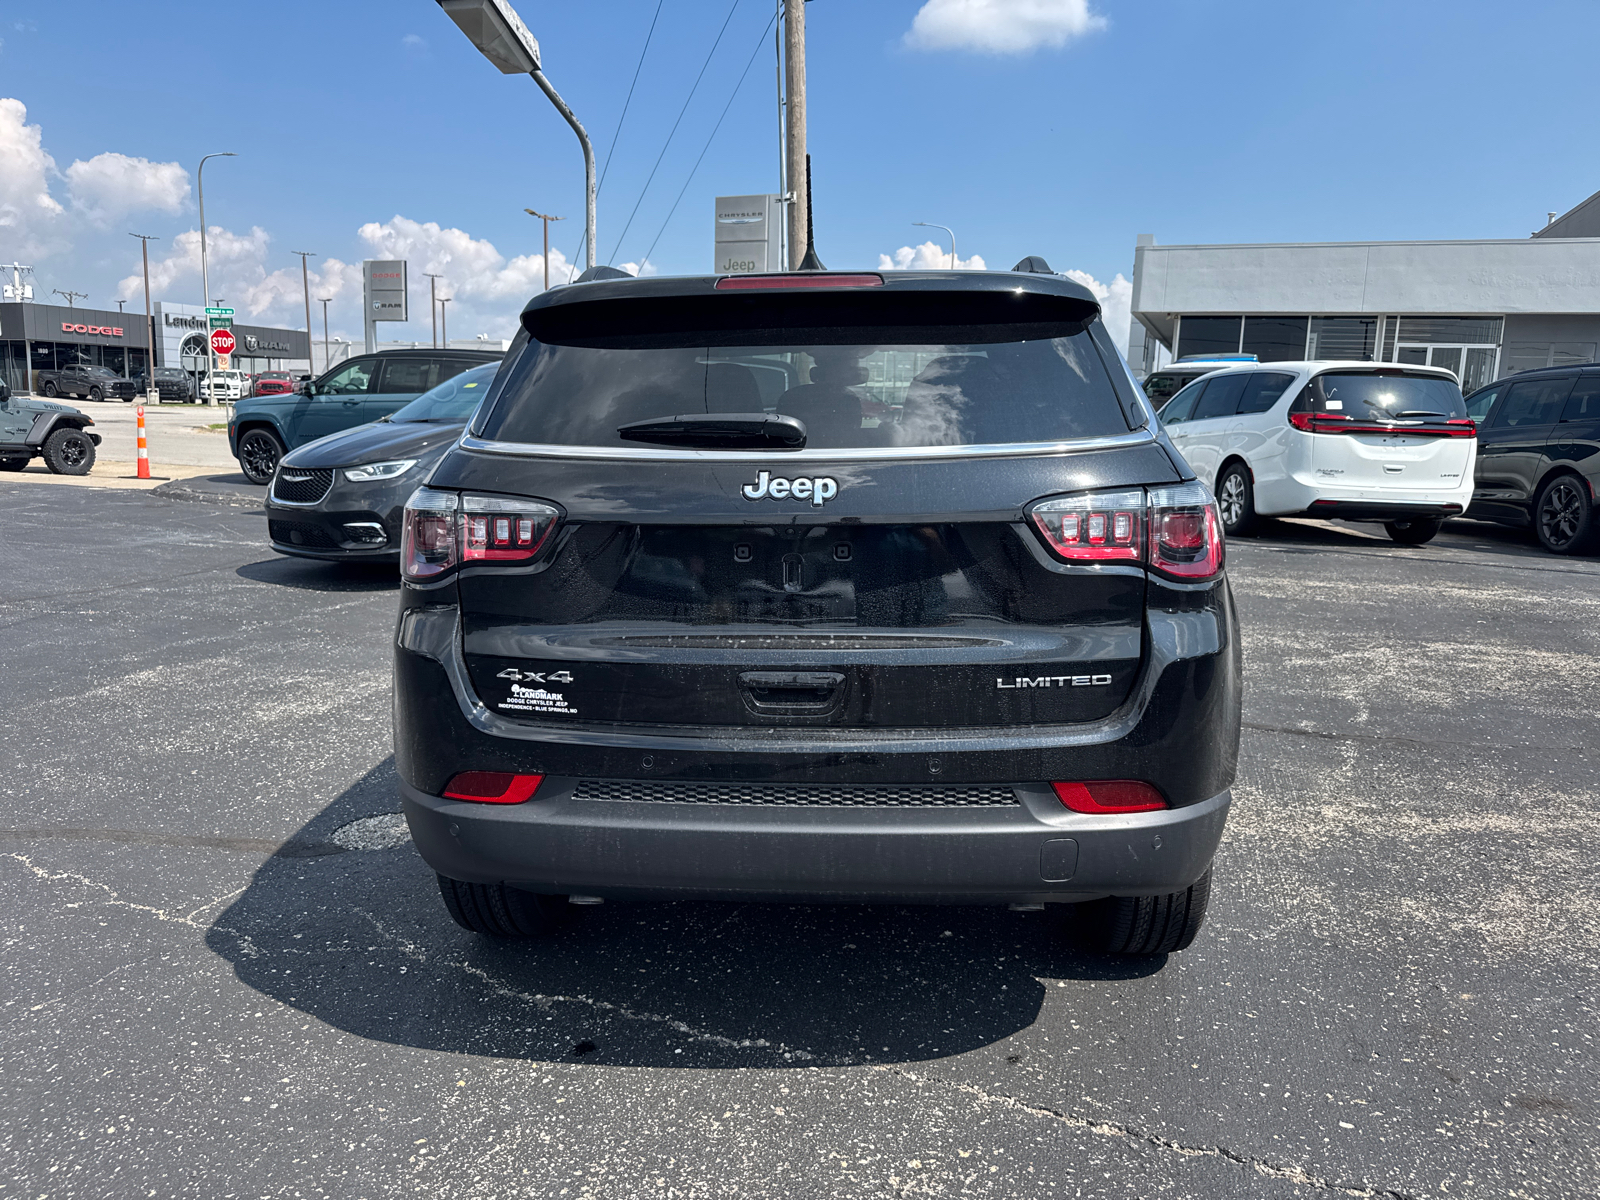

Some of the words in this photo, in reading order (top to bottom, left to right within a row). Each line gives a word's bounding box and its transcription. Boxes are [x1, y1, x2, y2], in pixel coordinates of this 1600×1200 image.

[723, 258, 755, 272] Jeep
[61, 322, 124, 336] DODGE
[212, 336, 234, 348] STOP
[258, 341, 290, 351] RAM
[741, 470, 838, 507] Jeep
[496, 668, 574, 684] 4x4
[996, 674, 1112, 689] LIMITED
[520, 691, 563, 700] LANDMARK
